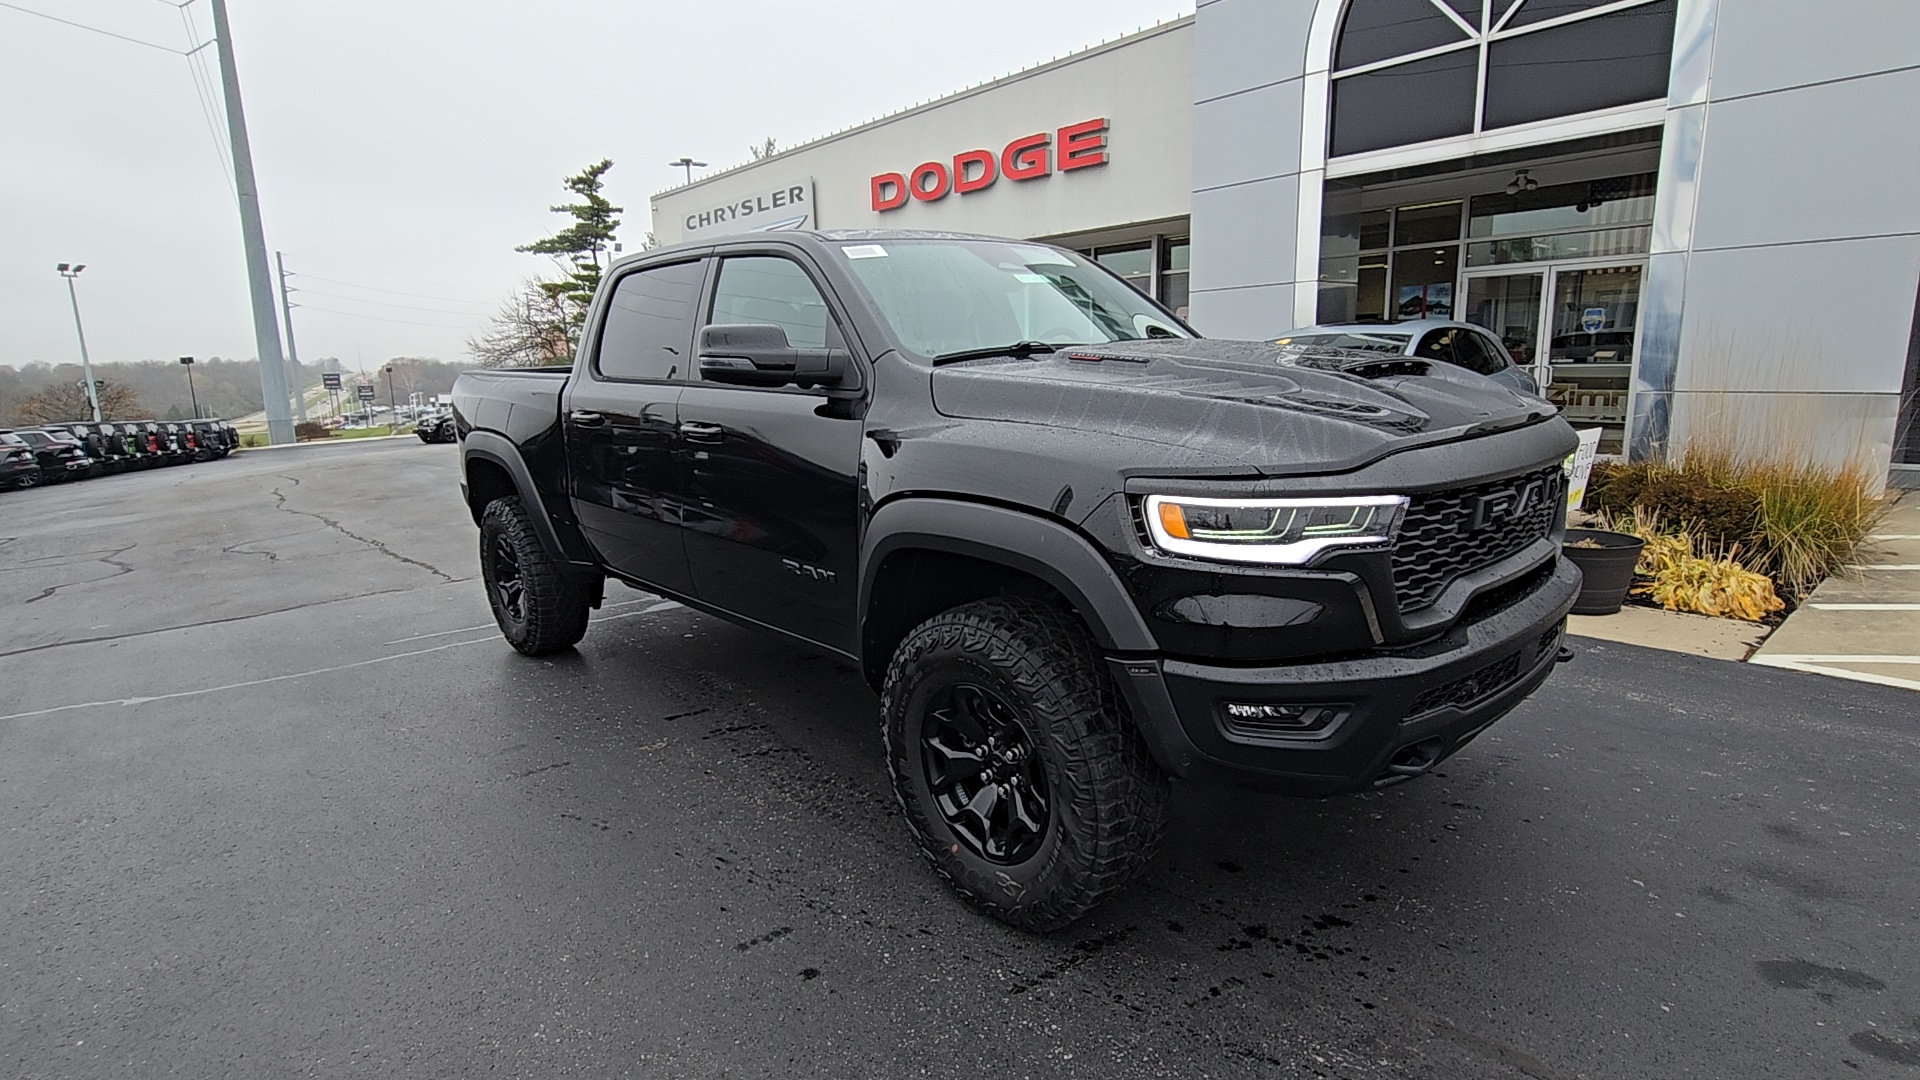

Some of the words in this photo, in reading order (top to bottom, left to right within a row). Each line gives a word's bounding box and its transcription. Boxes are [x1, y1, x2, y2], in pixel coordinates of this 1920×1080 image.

[870, 117, 1110, 212] DODGE
[685, 185, 805, 231] CHRYSLER
[782, 558, 838, 584] RAM
